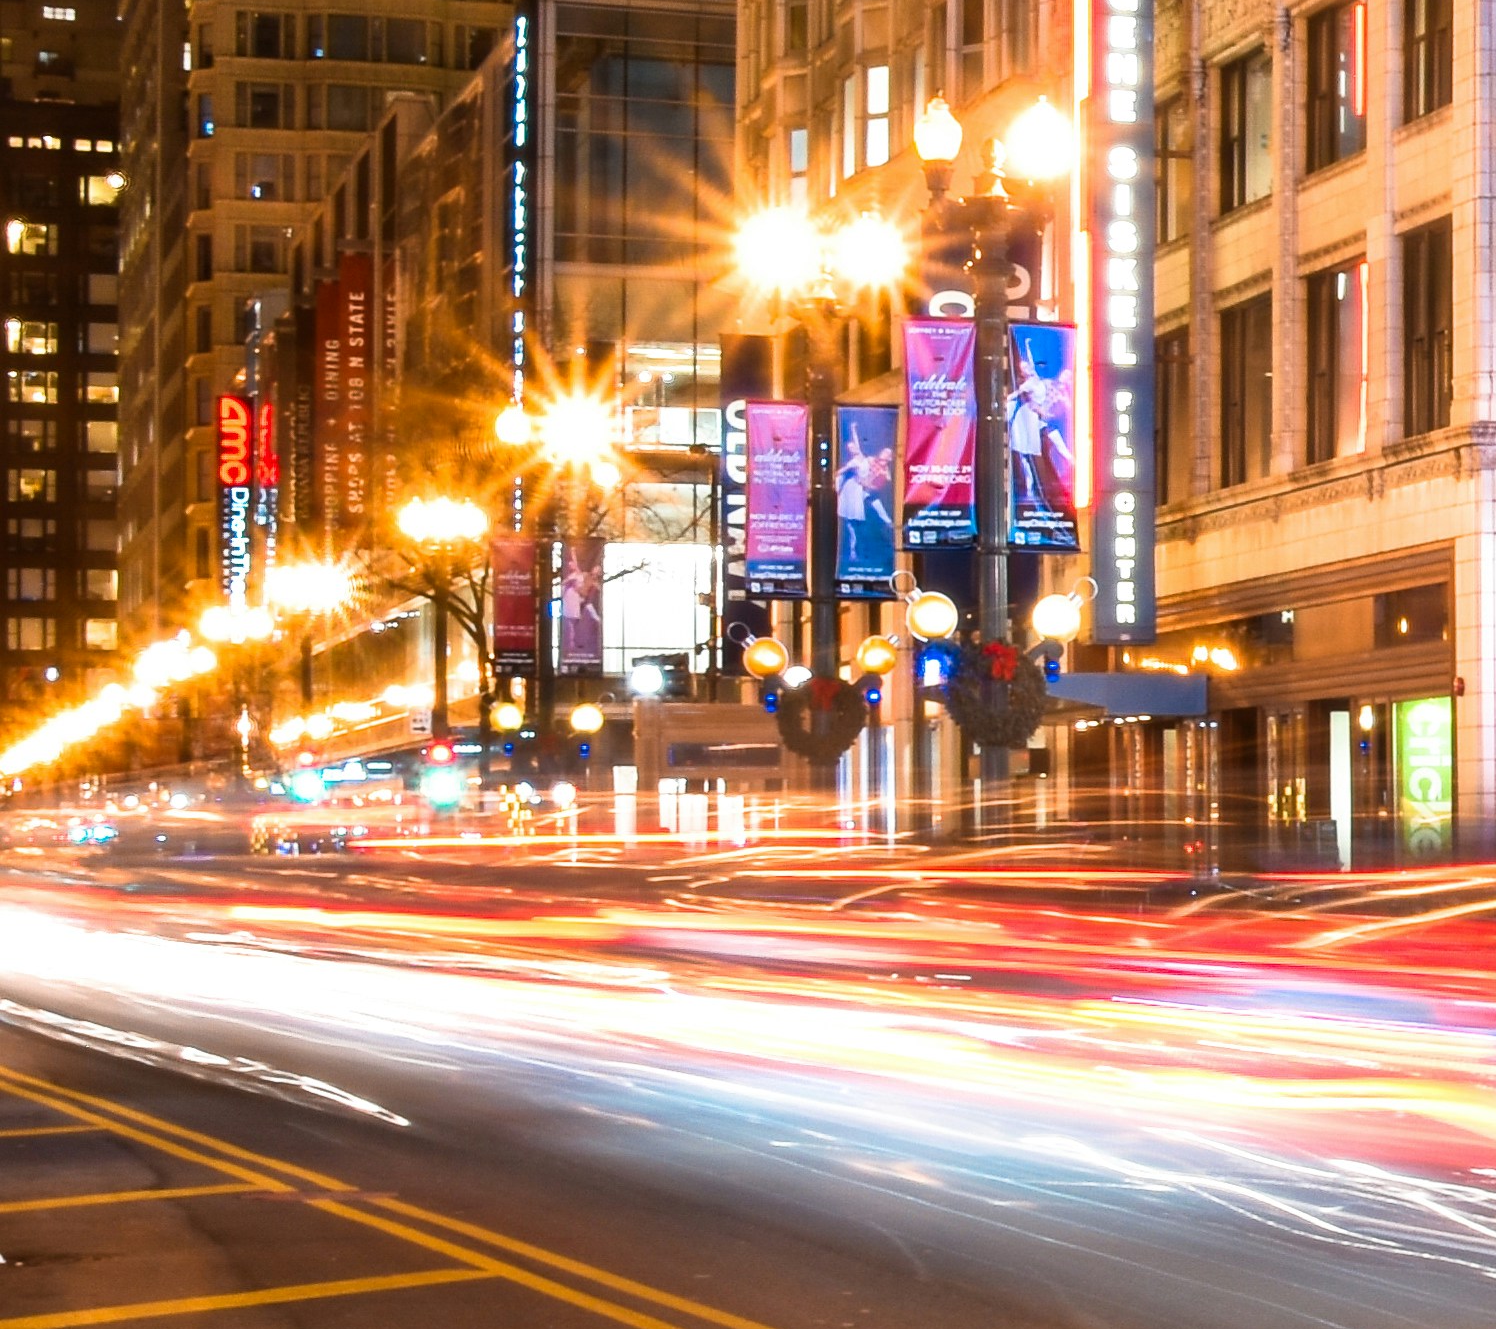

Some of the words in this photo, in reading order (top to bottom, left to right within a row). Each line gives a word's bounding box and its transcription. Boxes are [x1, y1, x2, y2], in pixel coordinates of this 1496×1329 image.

[1107, 145, 1140, 366] SISKEL
[348, 291, 365, 347] STATE
[348, 357, 365, 368] N
[1113, 391, 1136, 479] FILM
[1114, 491, 1136, 624] CENTER
